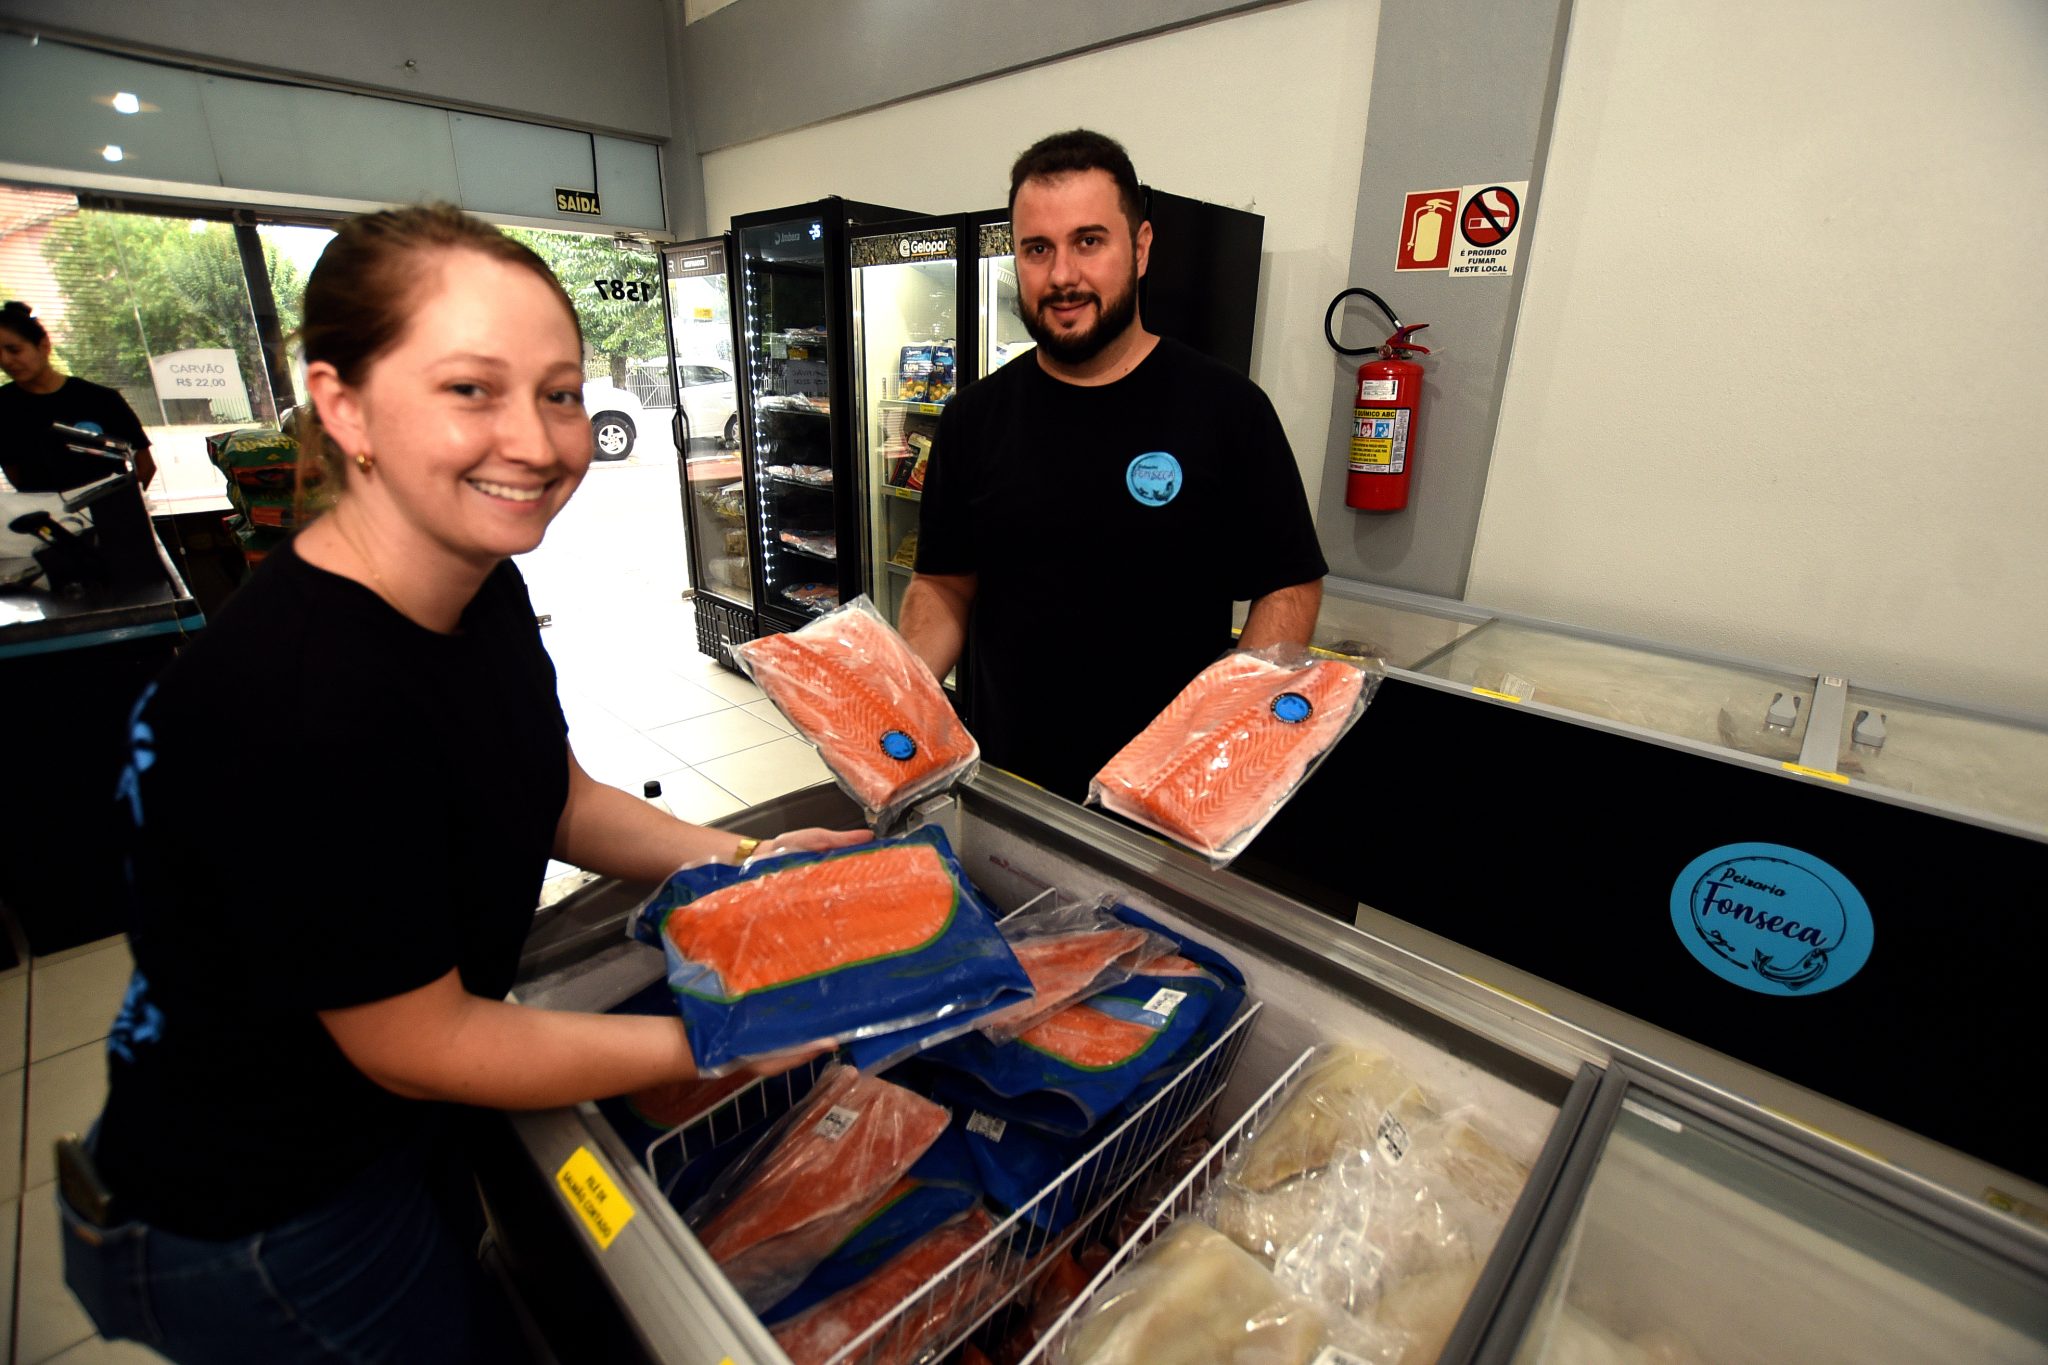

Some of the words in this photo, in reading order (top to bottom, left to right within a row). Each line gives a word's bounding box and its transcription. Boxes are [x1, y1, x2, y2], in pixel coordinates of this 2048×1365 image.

[557, 192, 600, 214] SAÍDA
[911, 239, 948, 255] Gelopar
[1460, 249, 1466, 257] É
[1467, 248, 1507, 257] PROIBIDO
[1467, 257, 1496, 265] FUMAR
[1453, 265, 1480, 273] NESTE
[1481, 265, 1508, 273] LOCAL
[169, 363, 225, 375] CARVÃO
[176, 378, 193, 388] R$
[195, 378, 226, 388] 22,00
[1381, 410, 1396, 418] ABC
[1719, 867, 1787, 897] Peixaria
[1702, 880, 1827, 947] Fonseca
